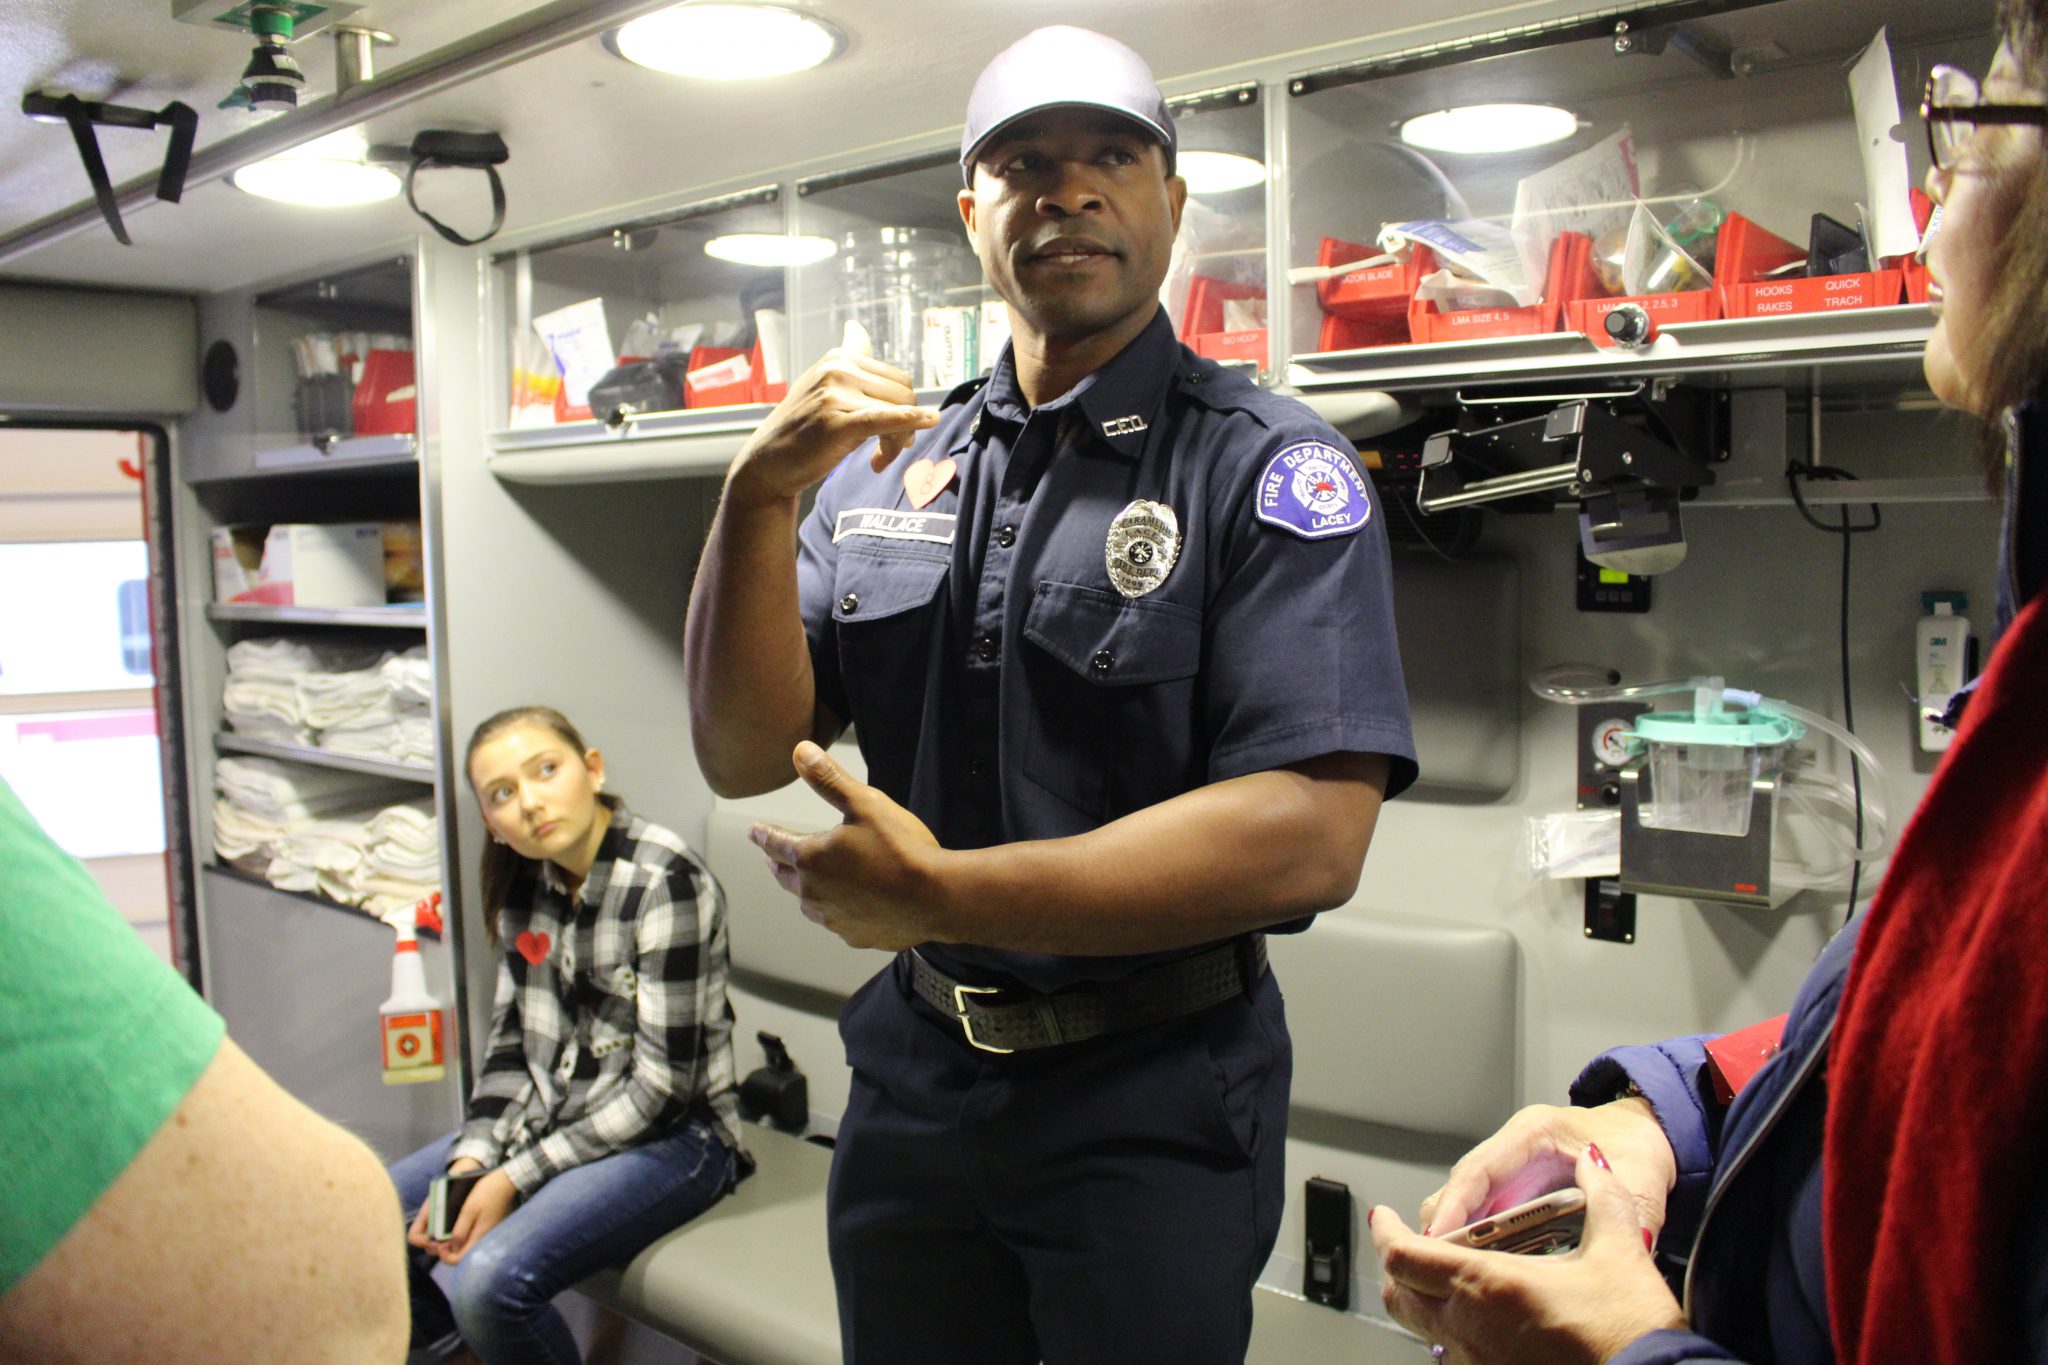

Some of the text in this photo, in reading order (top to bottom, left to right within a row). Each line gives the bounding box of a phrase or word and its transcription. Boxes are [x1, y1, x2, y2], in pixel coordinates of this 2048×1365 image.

[1367, 269, 1393, 281] BLADE
[1755, 284, 1793, 297] HOOKS
[1825, 278, 1860, 291] QUICK
[1757, 301, 1793, 312] RAKES
[1824, 295, 1862, 307] TRACH
[1452, 315, 1471, 326] LMA
[1472, 313, 1491, 323] SIZE
[1263, 471, 1285, 507] FIRE
[1283, 446, 1368, 501] DEPARTMENT
[860, 514, 927, 532] WALLACE
[1122, 515, 1175, 537] PARAMEDIC
[1311, 513, 1351, 529] LACEY
[1114, 559, 1133, 575] FIRE
[1121, 577, 1143, 587] 1999
[1930, 637, 1947, 647] 3M
